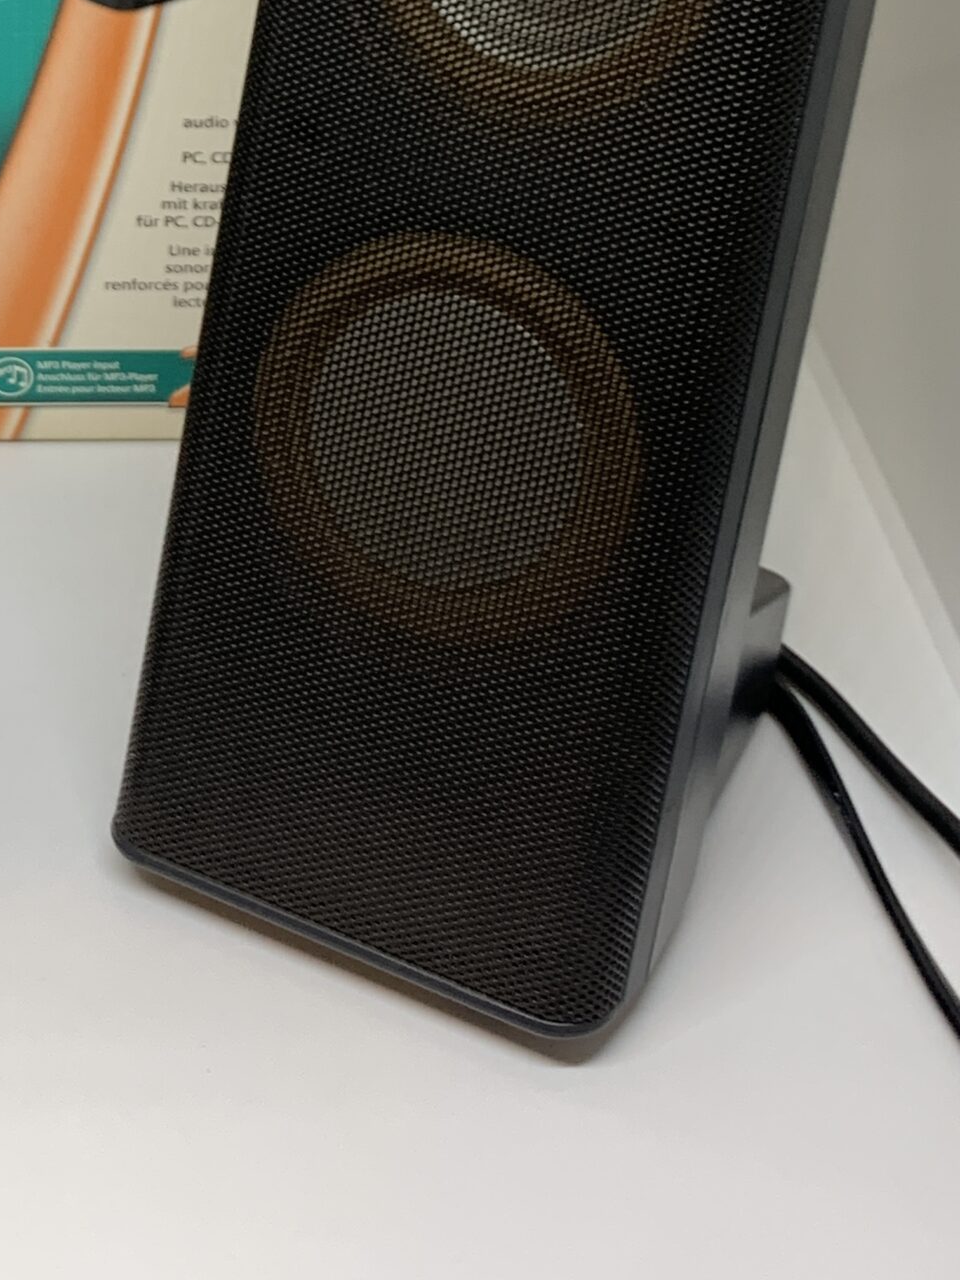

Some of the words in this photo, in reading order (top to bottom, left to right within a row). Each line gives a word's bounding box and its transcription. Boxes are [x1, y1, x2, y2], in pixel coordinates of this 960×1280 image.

[183, 116, 230, 128] audio
[161, 198, 188, 210] mit
[136, 215, 160, 227] für
[168, 245, 201, 256] Une
